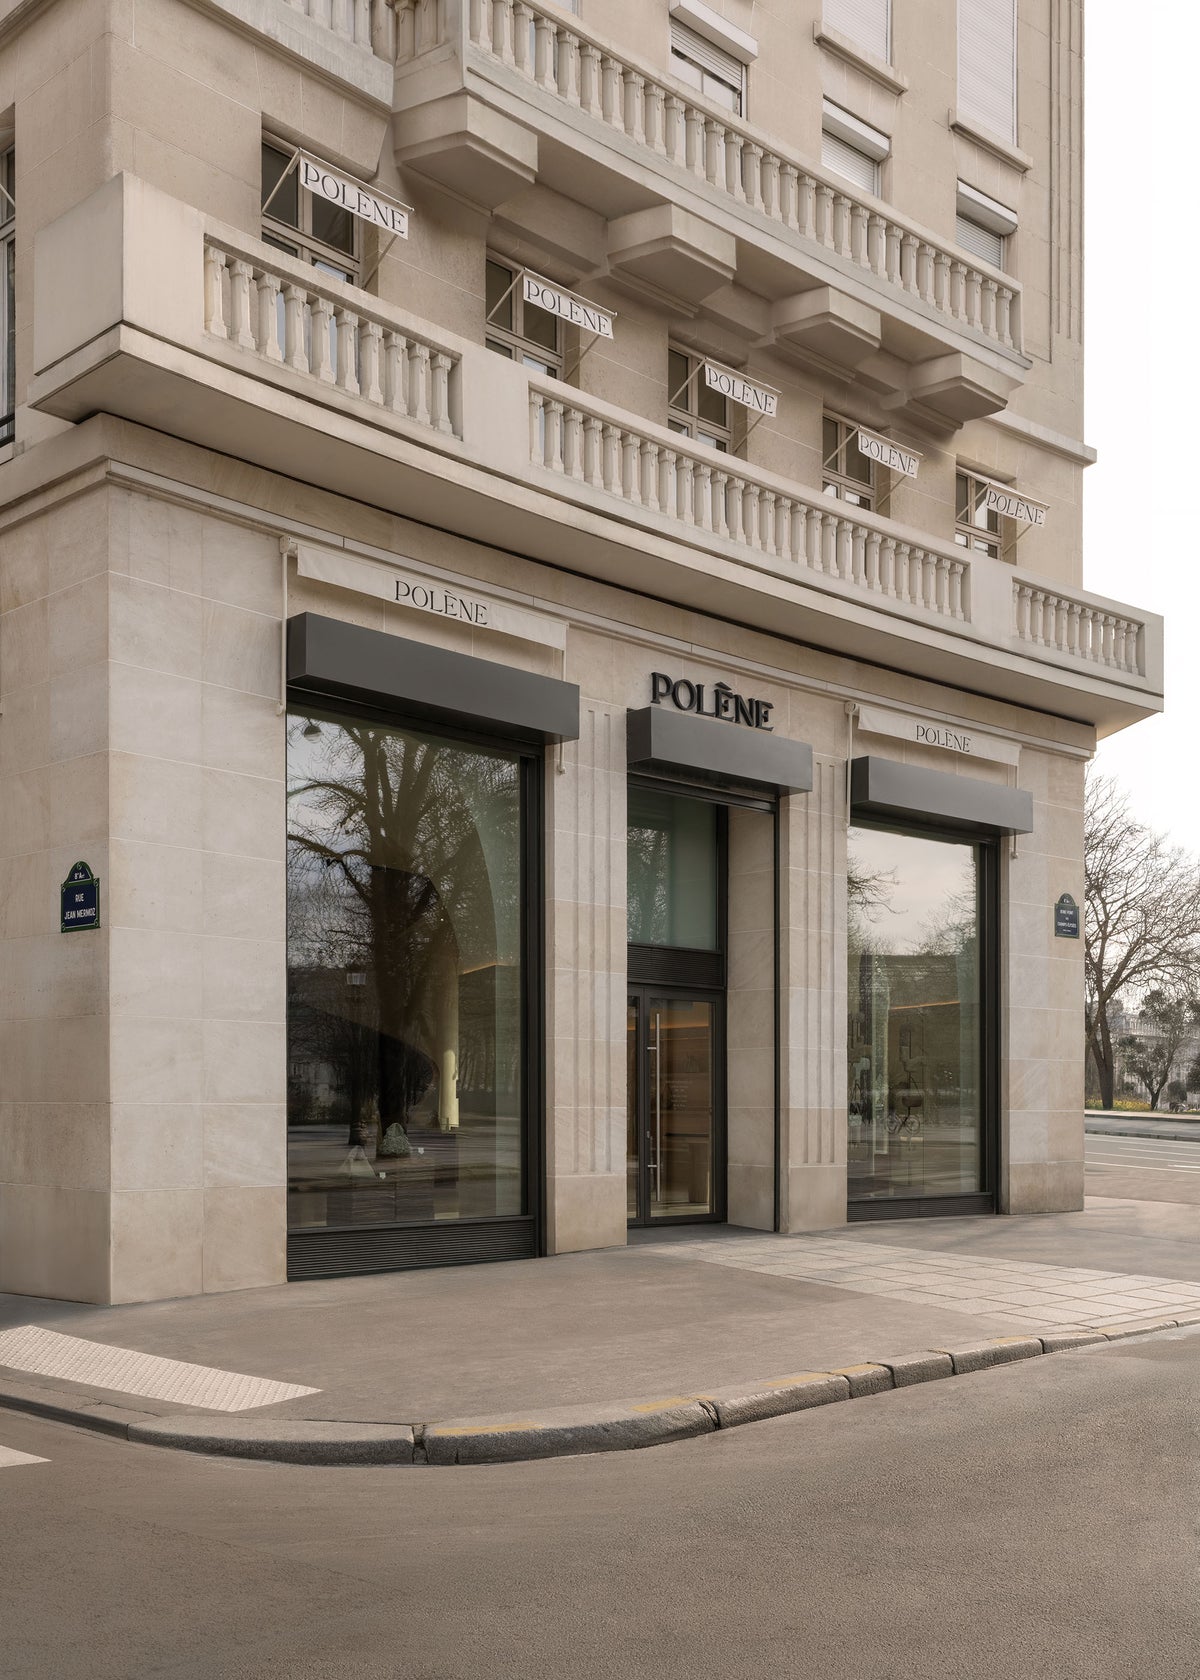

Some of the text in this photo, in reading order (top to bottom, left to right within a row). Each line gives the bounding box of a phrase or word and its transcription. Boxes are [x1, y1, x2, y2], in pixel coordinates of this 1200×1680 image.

[304, 162, 405, 234] POLÈNE
[527, 280, 610, 336] POLÈNE
[395, 580, 488, 625] POLÈNE
[651, 671, 775, 732] POLÈNE
[916, 725, 971, 752] POLÈNE
[64, 910, 76, 920] JEAN
[74, 893, 85, 903] RUE
